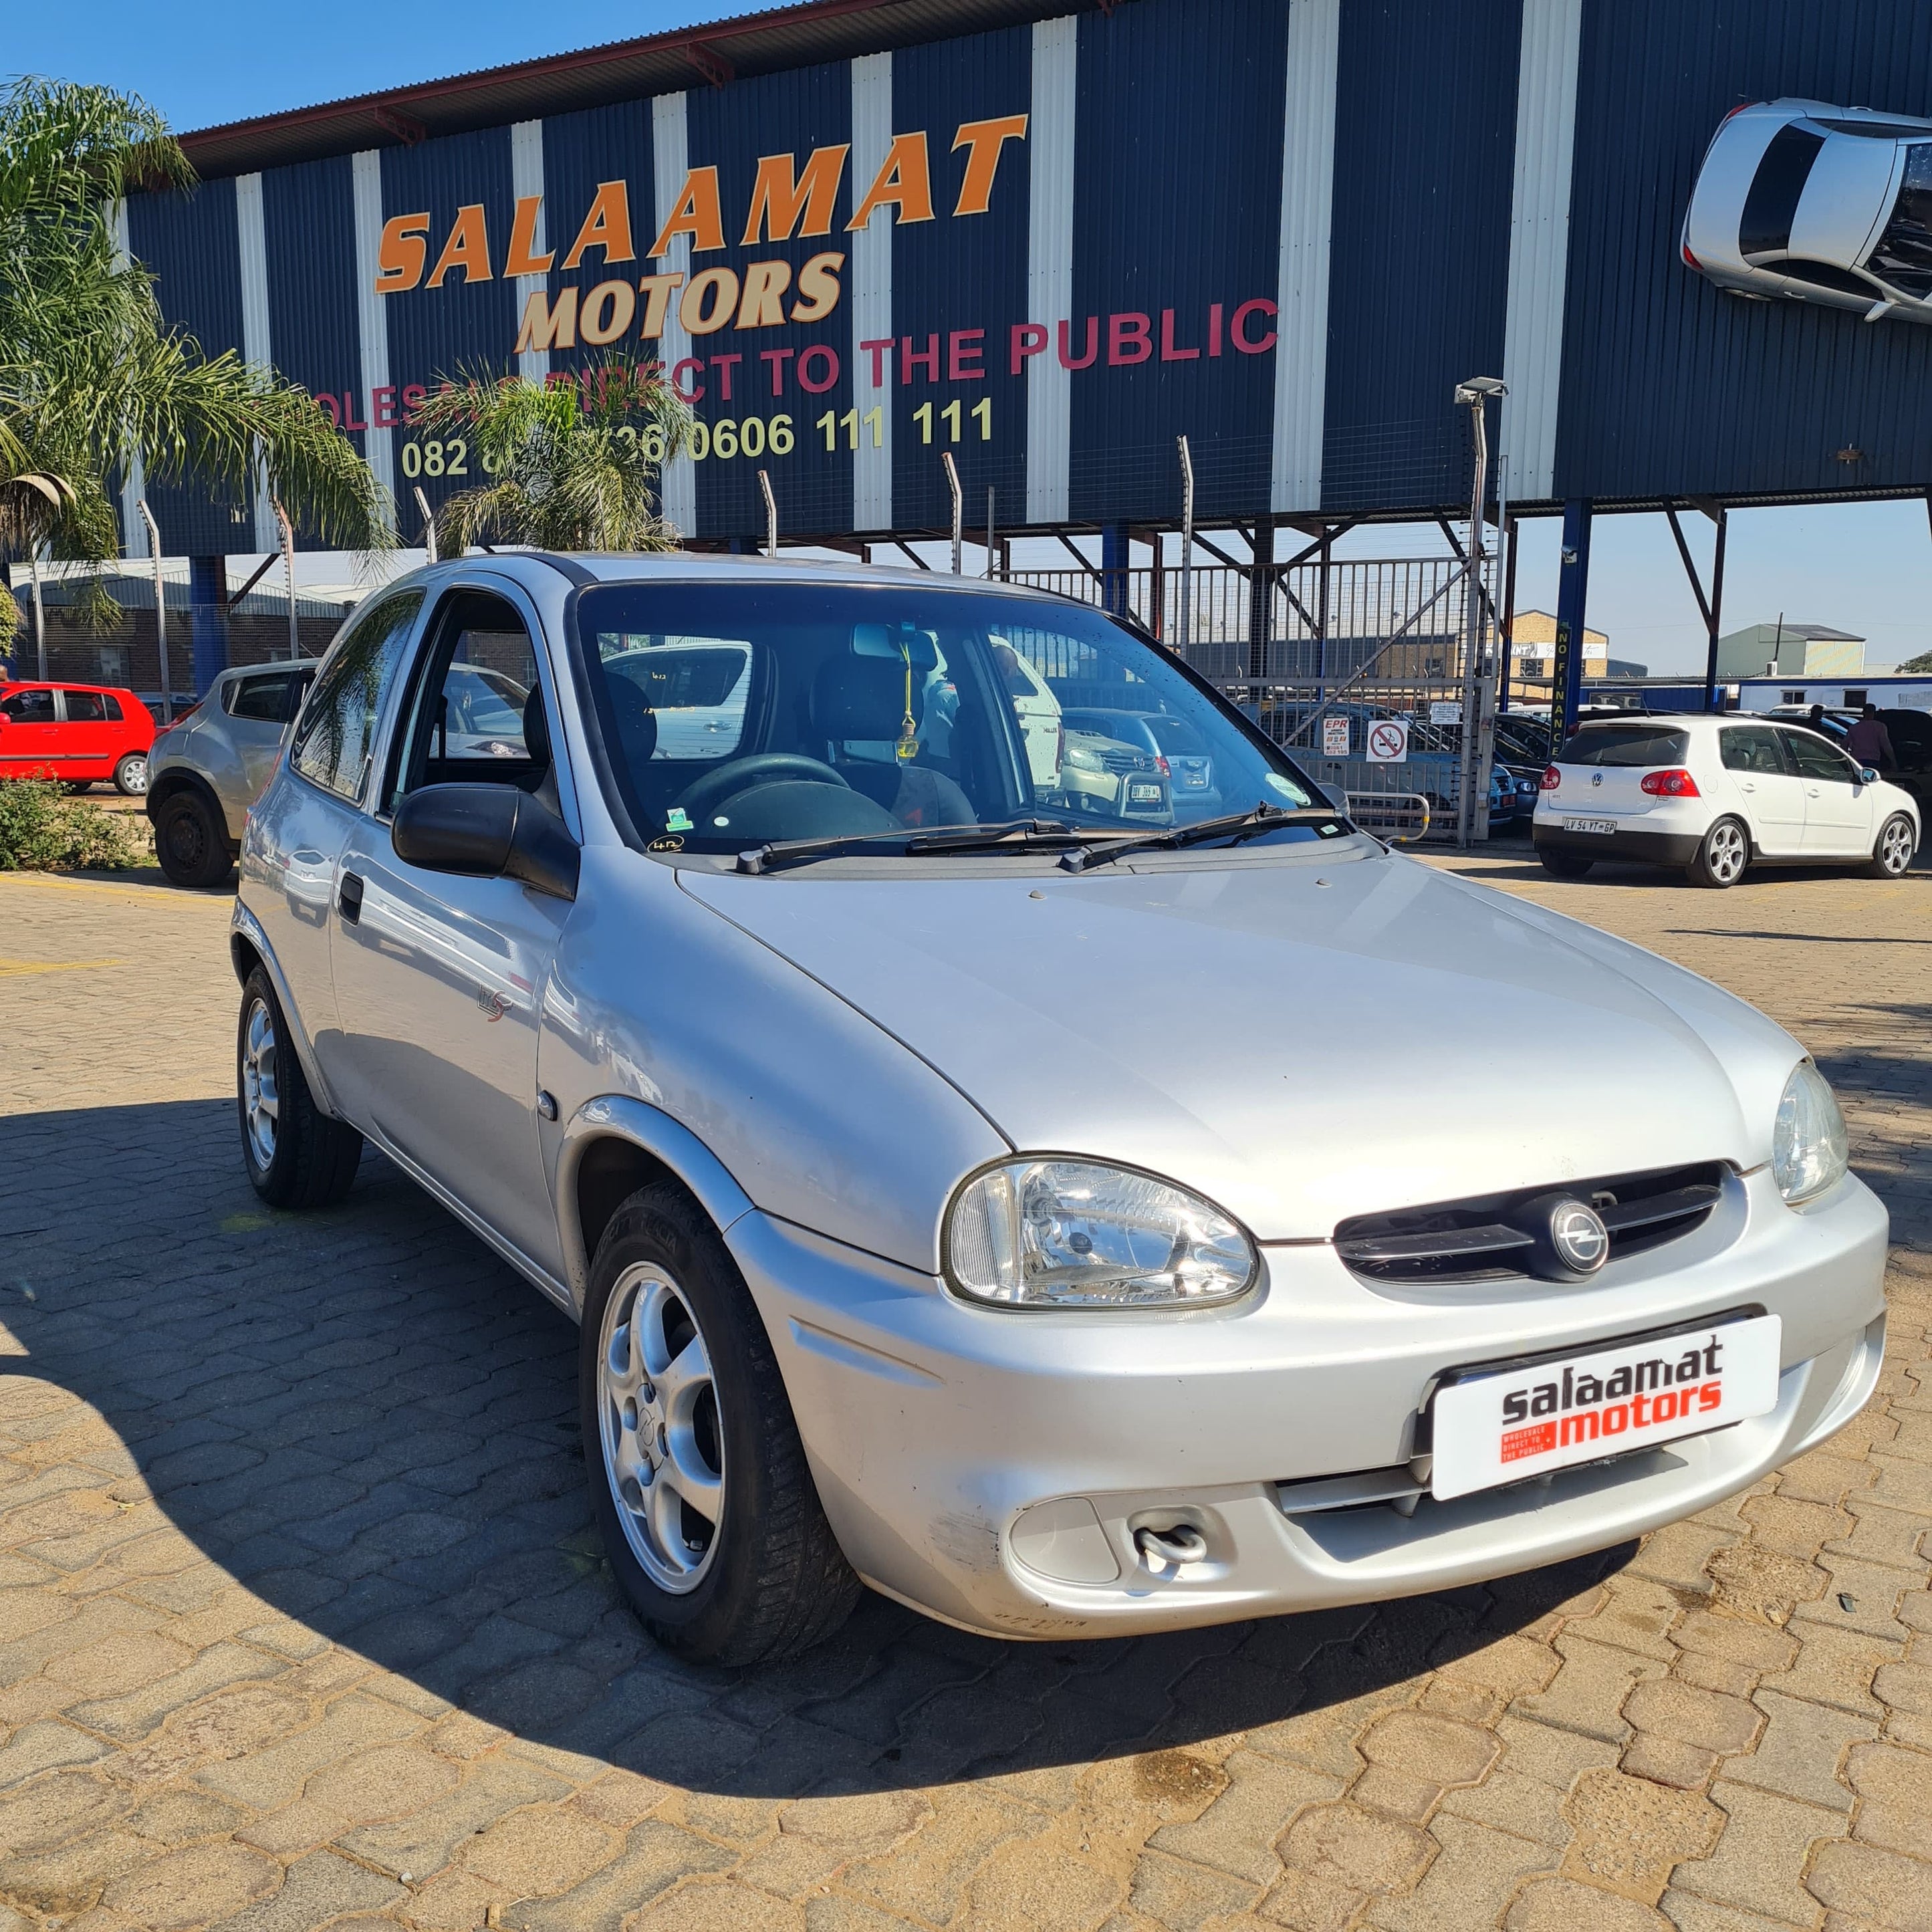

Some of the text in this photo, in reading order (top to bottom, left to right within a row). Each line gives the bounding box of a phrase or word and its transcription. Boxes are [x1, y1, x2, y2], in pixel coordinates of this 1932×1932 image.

[374, 113, 1029, 295] SALAAMAT
[513, 251, 846, 354] MOTORS
[761, 344, 840, 396] TO
[860, 328, 986, 389] THE
[1010, 298, 1280, 376] PUBLIC
[402, 439, 468, 479] 082
[816, 406, 884, 452] 111
[913, 397, 992, 445] 111
[1325, 719, 1348, 728] EPR
[1551, 633, 1568, 756] NO FINANCE
[1566, 820, 1614, 832] LV 54 YT GP
[1502, 1334, 1723, 1426] salaamat
[1560, 1380, 1722, 1448] motors
[1502, 1443, 1544, 1461] THE PUBLIC
[1503, 1425, 1546, 1443] WHOLESALE
[1503, 1436, 1541, 1453] DIRECT TO
